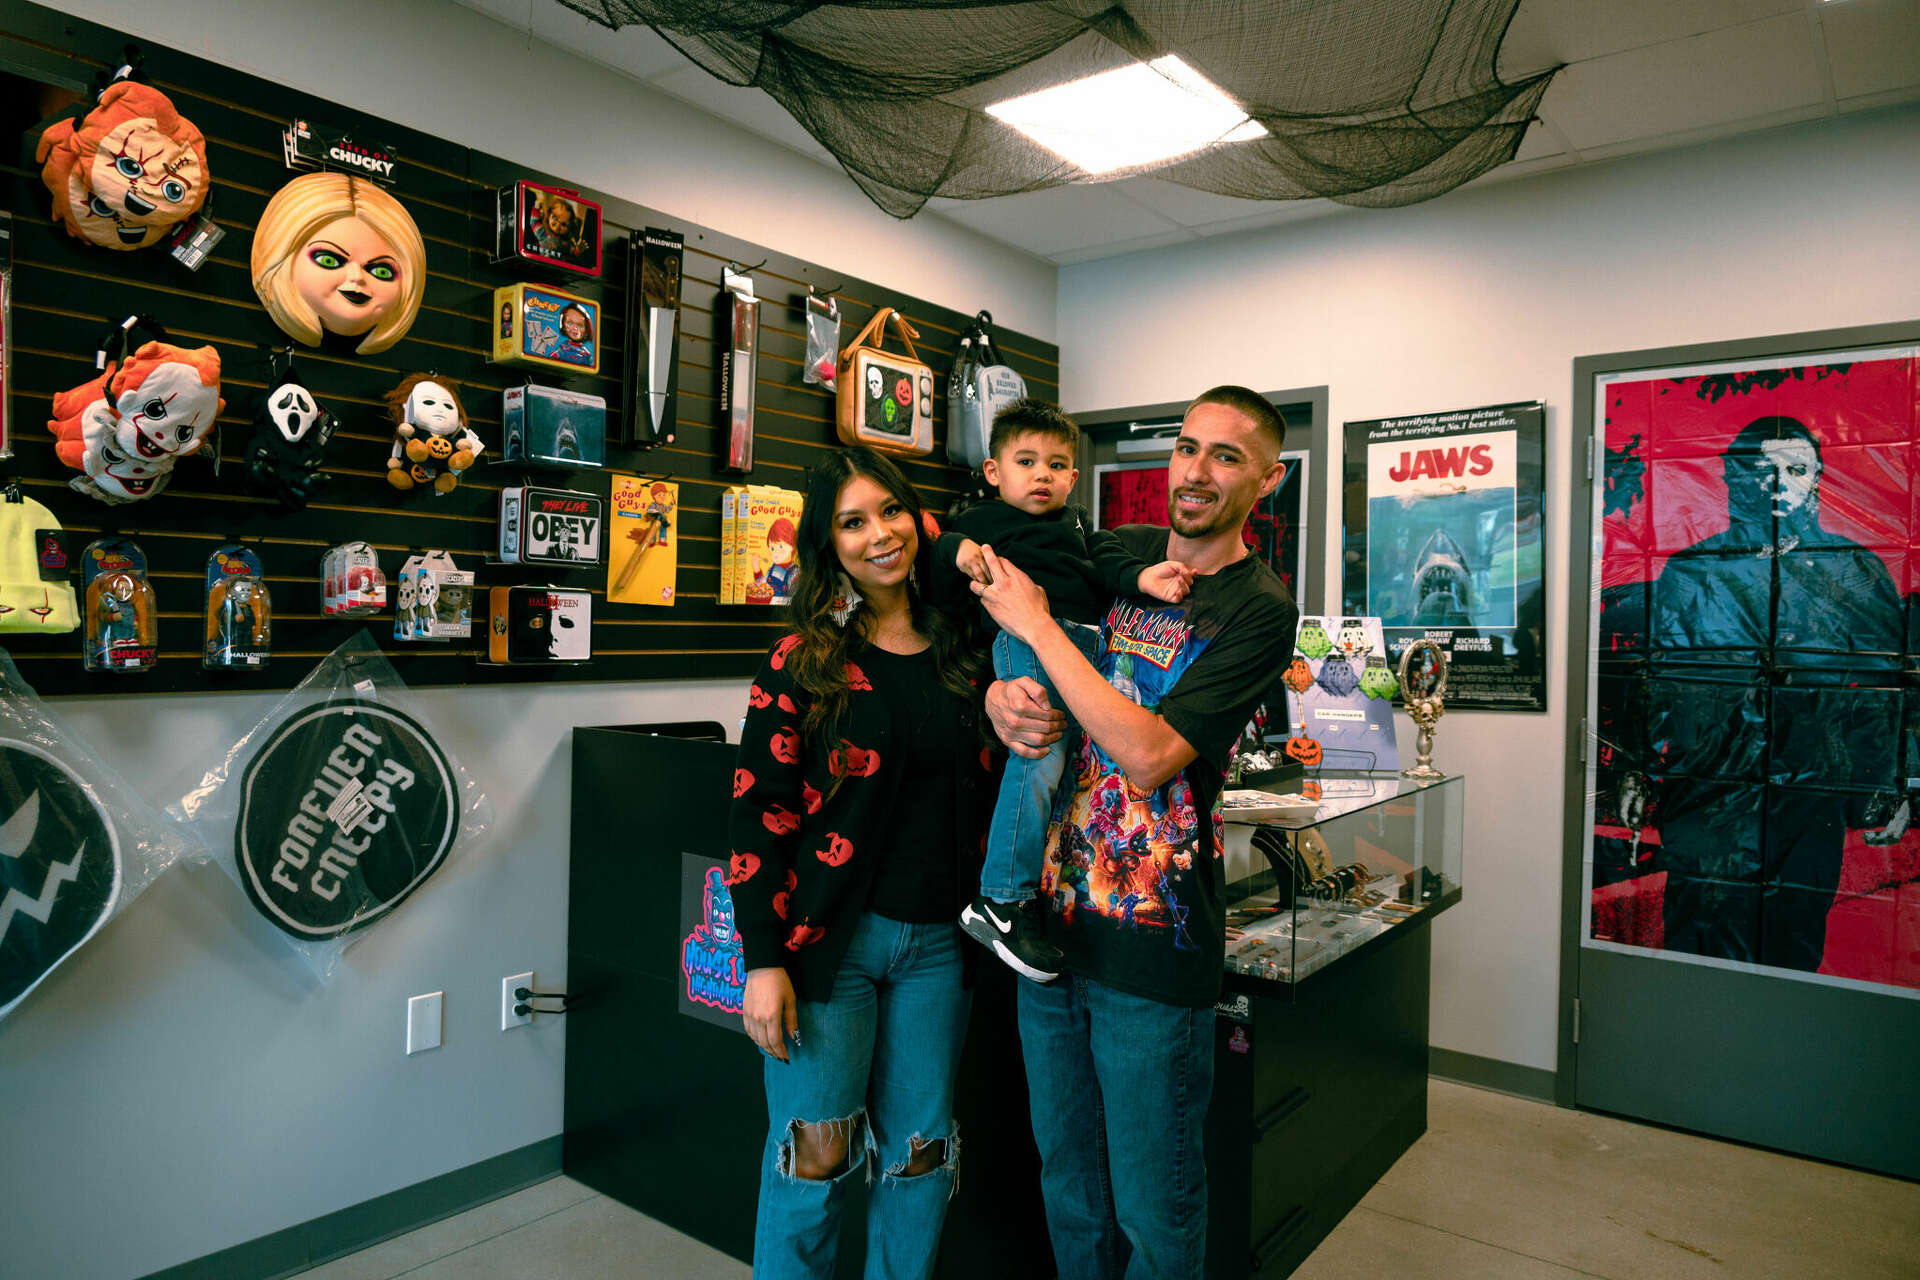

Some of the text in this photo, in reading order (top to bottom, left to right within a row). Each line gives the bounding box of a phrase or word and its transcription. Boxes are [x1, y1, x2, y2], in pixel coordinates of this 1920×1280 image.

[329, 147, 394, 177] CHUCKY
[373, 151, 389, 161] OF
[645, 235, 682, 250] HALLOWEEN
[721, 351, 730, 411] HALLOWEEN
[1380, 410, 1505, 429] The terrifying motion picture
[1368, 430, 1389, 439] from
[1405, 424, 1446, 435] terrifying
[1468, 420, 1488, 429] best
[1389, 444, 1494, 482] JAWS
[613, 489, 642, 502] Good
[541, 500, 589, 513] THEY LIVE
[617, 499, 646, 510] Guys
[751, 505, 776, 516] Good
[532, 513, 597, 546] OBEY
[1424, 630, 1454, 638] ROBERT
[109, 648, 156, 659] CHUCKY
[1144, 645, 1171, 665] SPACE
[1453, 644, 1493, 652] DREYFUSS
